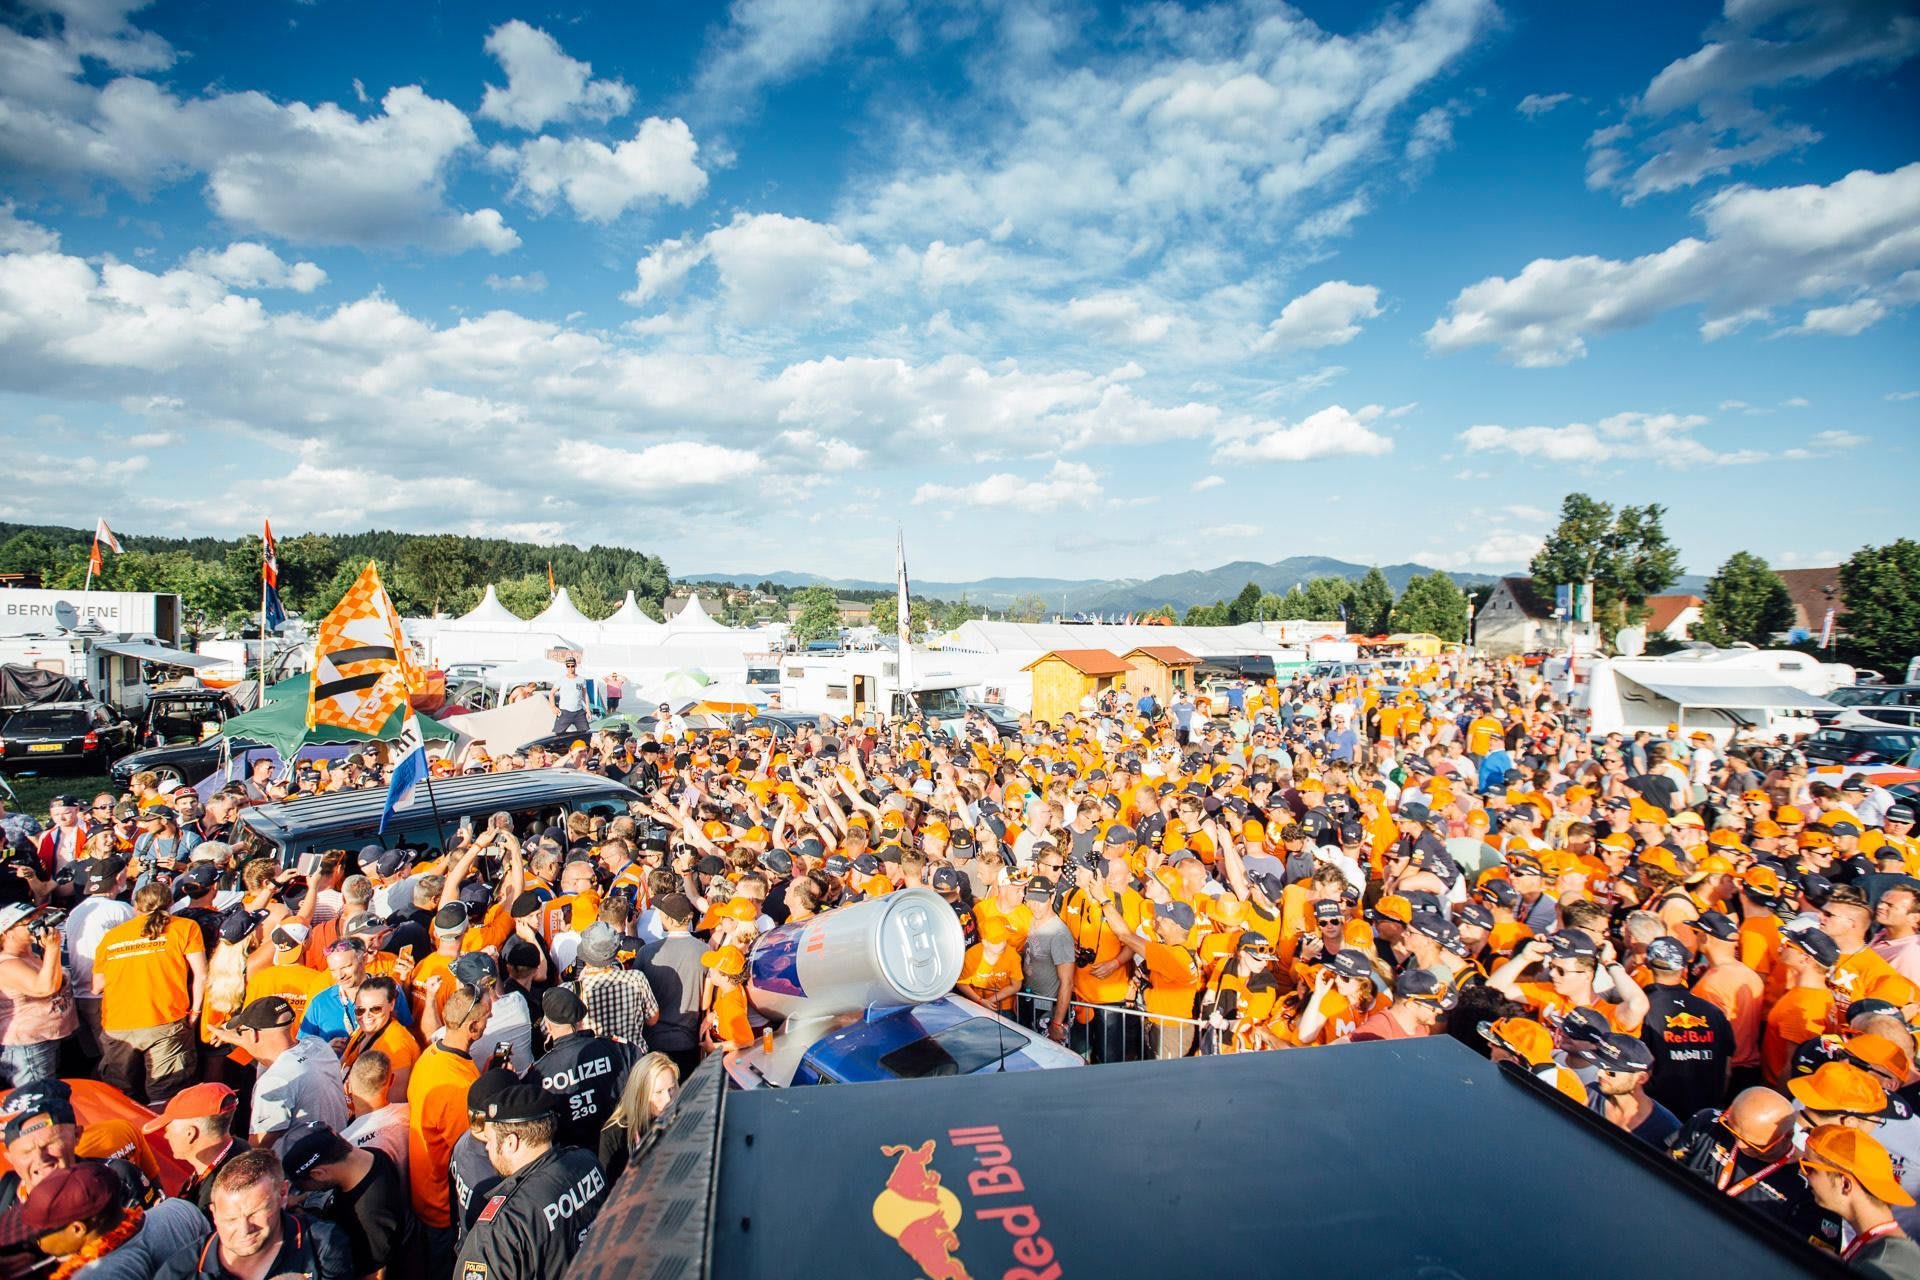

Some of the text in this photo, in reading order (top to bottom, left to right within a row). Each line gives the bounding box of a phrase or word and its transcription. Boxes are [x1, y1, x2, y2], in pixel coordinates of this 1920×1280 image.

[1663, 1030, 1714, 1043] Red Bull
[1669, 1049, 1701, 1061] Mobil
[542, 1056, 612, 1090] POLIZEI
[569, 1088, 595, 1110] ST
[571, 1104, 598, 1121] 230
[543, 1166, 605, 1232] POLIZEI
[948, 1125, 1064, 1280] Red Bull
[466, 1262, 487, 1272] POLIZEI
